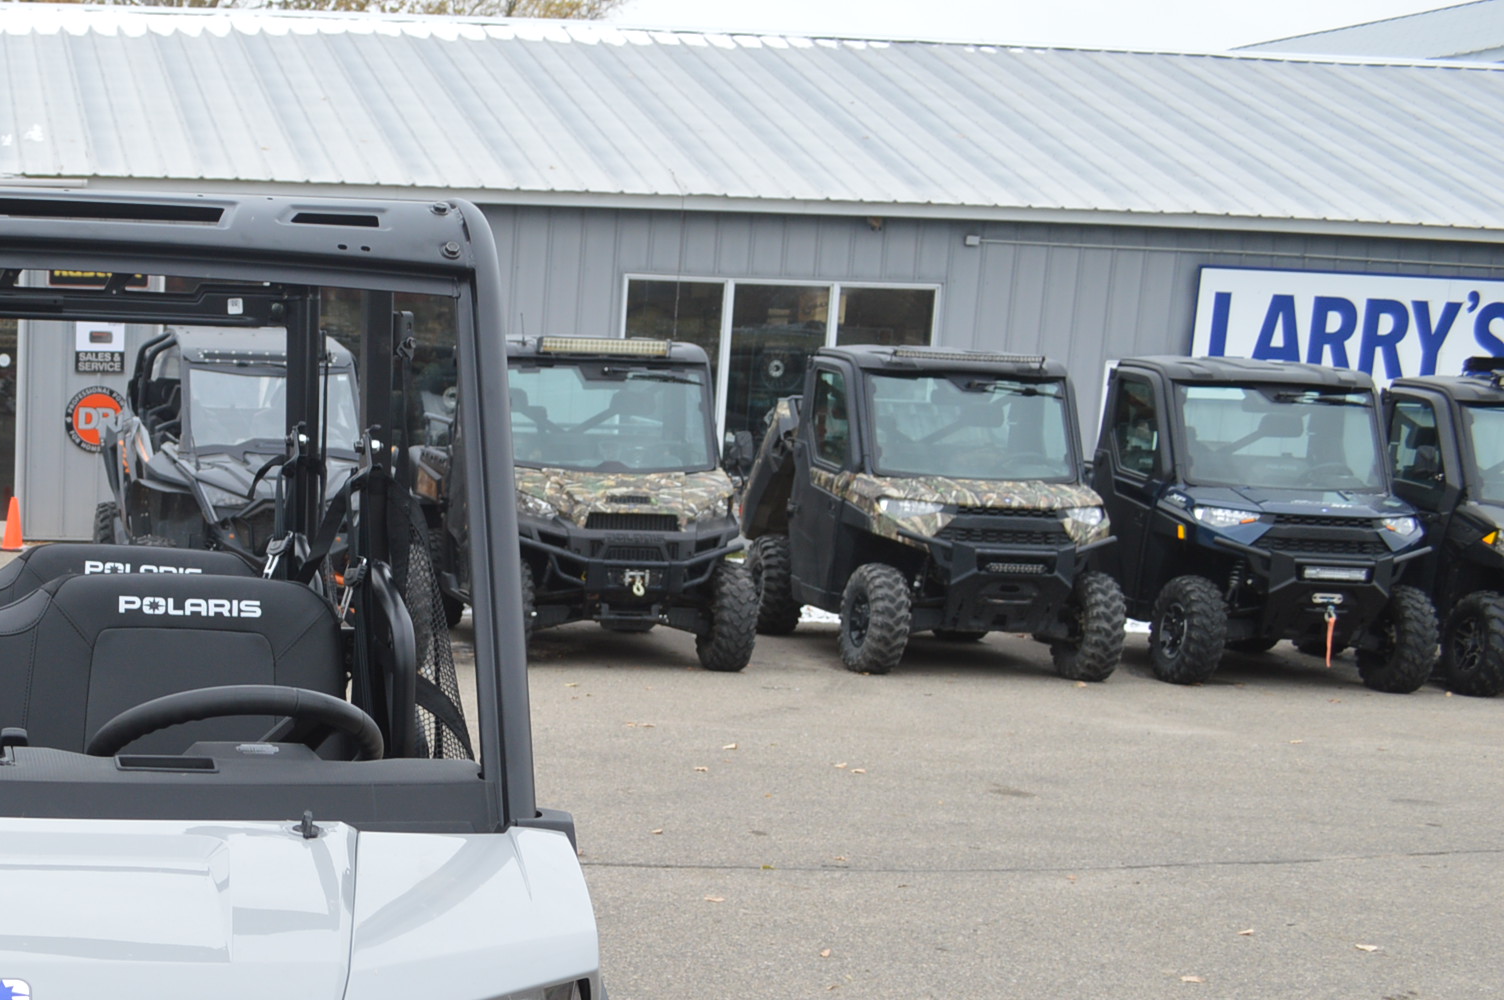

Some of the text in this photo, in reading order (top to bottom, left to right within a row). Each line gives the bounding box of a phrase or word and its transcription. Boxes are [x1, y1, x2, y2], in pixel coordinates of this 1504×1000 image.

[78, 352, 121, 362] SALES &
[77, 362, 122, 372] SERVICE
[118, 595, 262, 618] POLARIS
